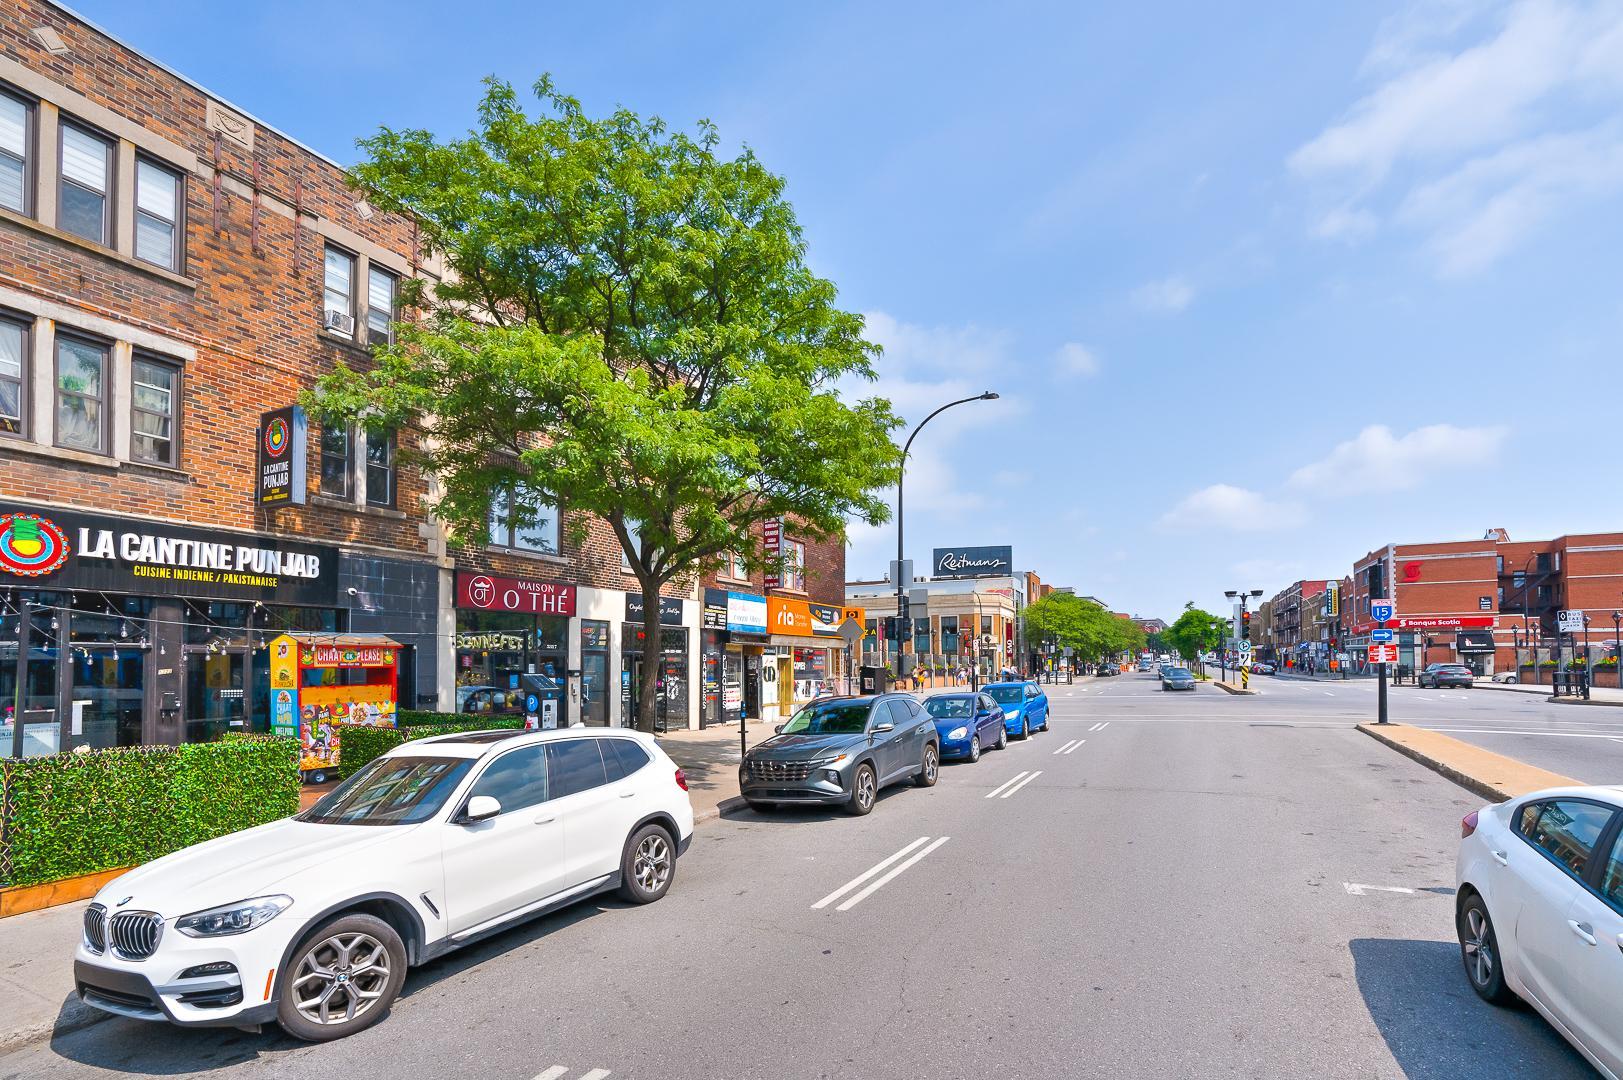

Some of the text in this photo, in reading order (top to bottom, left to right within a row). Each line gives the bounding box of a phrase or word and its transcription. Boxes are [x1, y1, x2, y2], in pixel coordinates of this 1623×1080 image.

[263, 465, 270, 475] LA
[263, 472, 289, 489] PUNJAB
[77, 527, 320, 579] LA CANTINE PUNJAB
[938, 552, 1007, 571] Reitmans
[133, 565, 171, 579] CUISINE
[173, 569, 214, 583] INDIENNE
[222, 573, 278, 587] PAKISTANAISE
[517, 581, 555, 593] MAISON
[503, 588, 568, 613] O THÉ
[777, 604, 794, 626] ria
[1376, 607, 1389, 617] 15
[1408, 619, 1436, 627] Banque
[317, 649, 342, 661] CHAAT
[357, 648, 380, 661] PLEASE
[331, 738, 340, 746] CH
